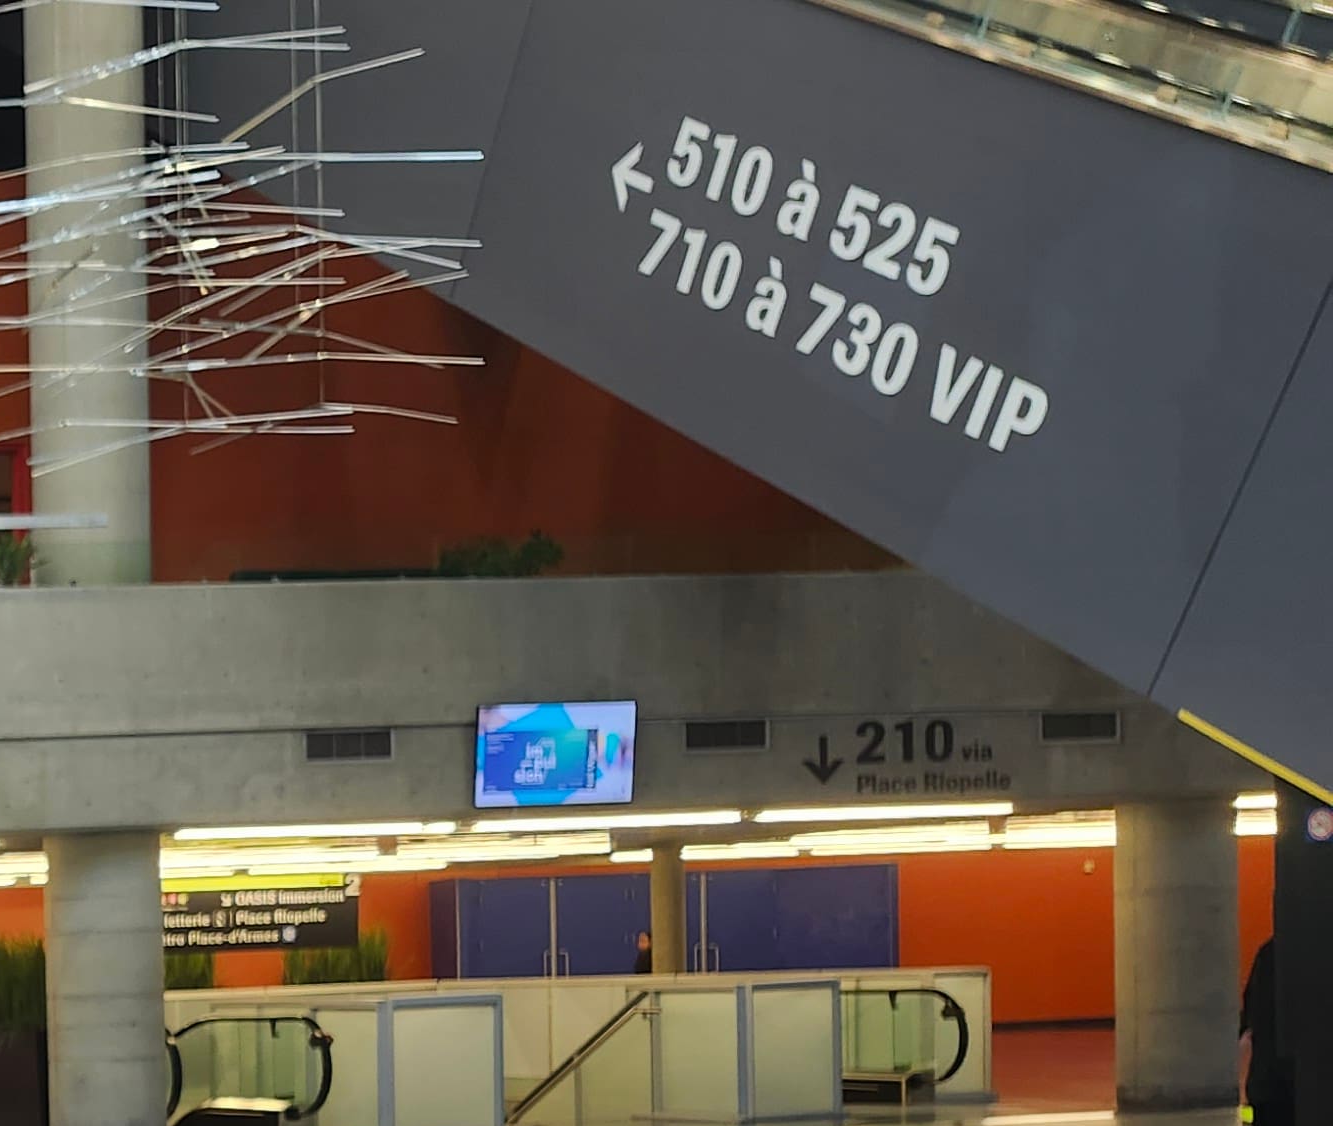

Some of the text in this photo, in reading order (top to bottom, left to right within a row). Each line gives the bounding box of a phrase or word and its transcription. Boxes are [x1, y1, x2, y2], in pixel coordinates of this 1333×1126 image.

[666, 116, 960, 296] 510 à 525
[637, 207, 1049, 453] 710 à 730 VIP
[856, 719, 993, 764] 210 via
[856, 774, 917, 794] Place
[344, 873, 362, 896] 2
